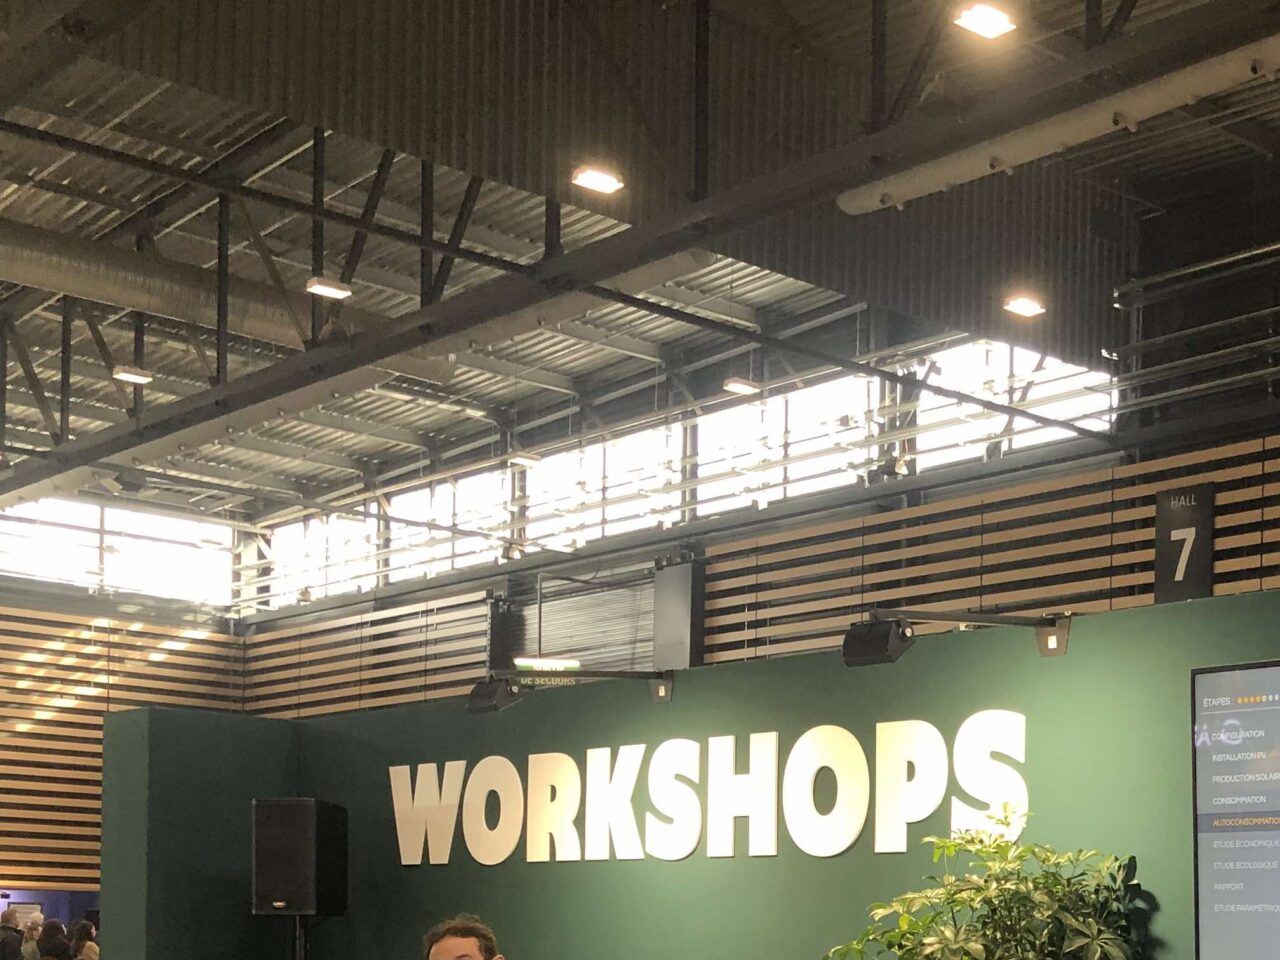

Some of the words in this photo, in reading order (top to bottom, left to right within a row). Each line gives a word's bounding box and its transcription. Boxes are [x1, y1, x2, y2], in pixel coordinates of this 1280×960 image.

[1170, 493, 1197, 510] HALL
[1170, 526, 1196, 582] 7
[1212, 773, 1256, 783] PRODUCTION
[388, 709, 1030, 866] WORKSHOPS
[1212, 795, 1267, 805] CONSOMMATION
